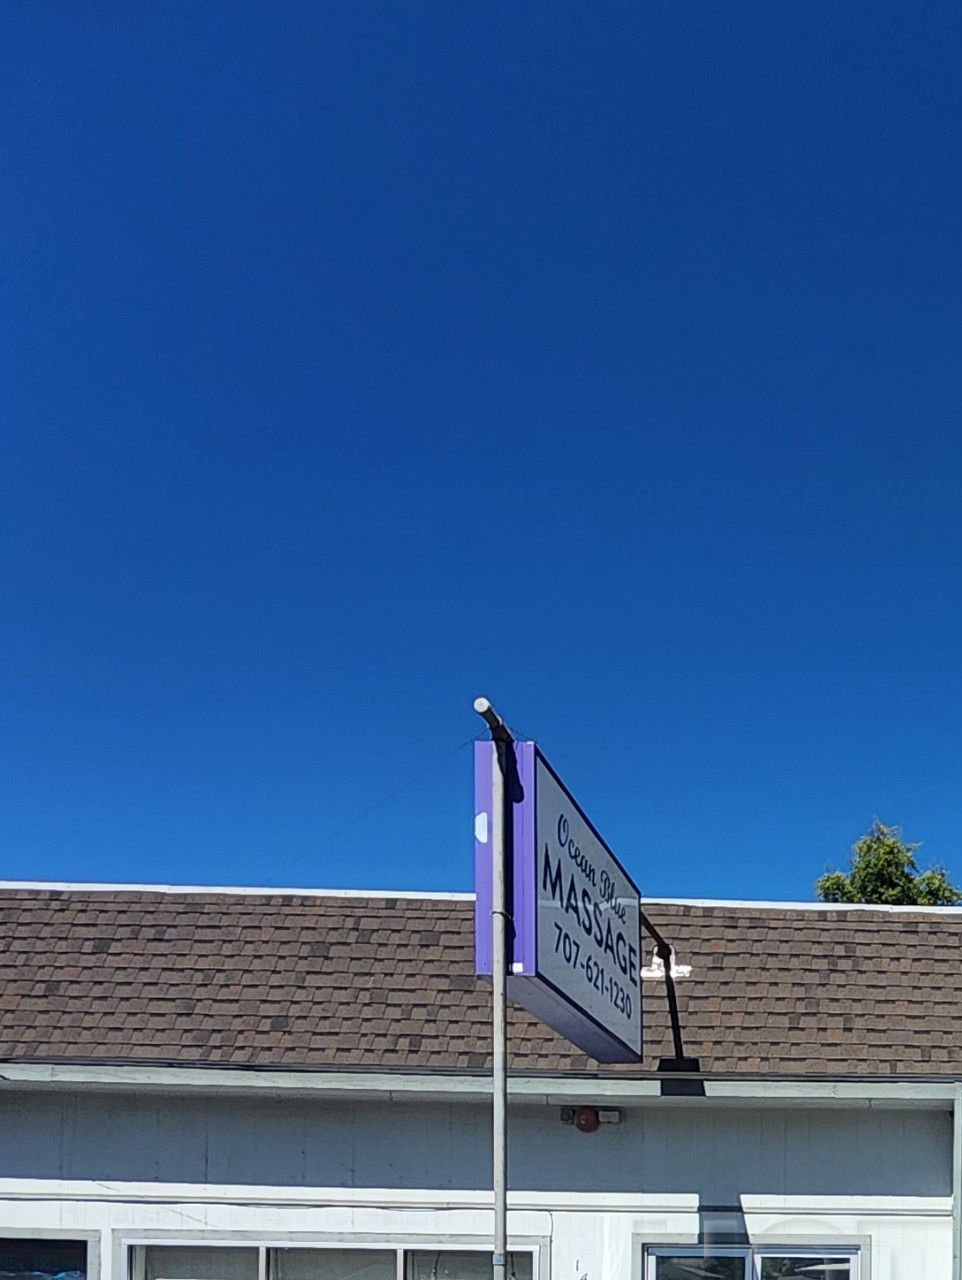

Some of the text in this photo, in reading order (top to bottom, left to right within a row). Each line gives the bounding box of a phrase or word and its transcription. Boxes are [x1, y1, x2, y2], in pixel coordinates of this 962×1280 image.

[542, 842, 638, 988] MASSAGE
[557, 813, 626, 925] Ocean Blue
[554, 921, 632, 1020] 707-621-1230
